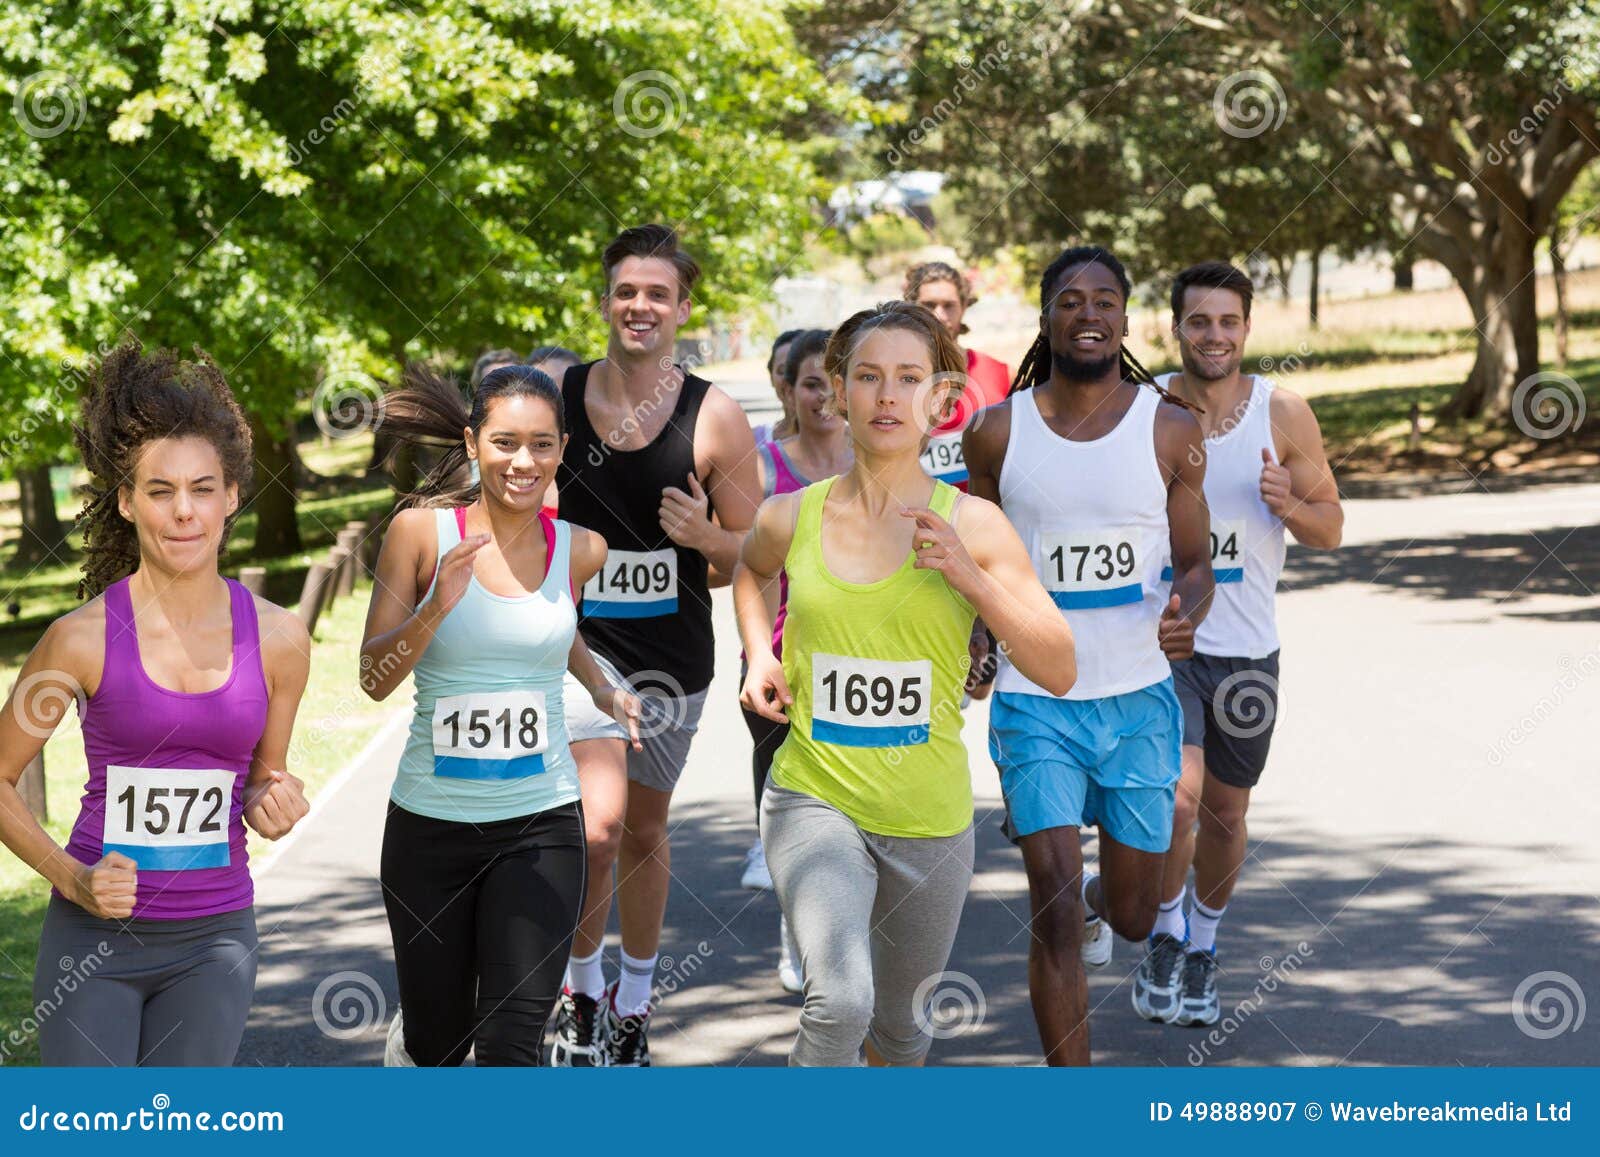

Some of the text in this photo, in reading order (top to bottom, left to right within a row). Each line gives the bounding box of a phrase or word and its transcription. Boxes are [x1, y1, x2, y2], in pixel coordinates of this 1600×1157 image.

[598, 561, 671, 595] 1409
[1049, 542, 1136, 582] 1739
[822, 669, 922, 717] 1695
[442, 707, 539, 749] 1518
[117, 784, 223, 835] 1572
